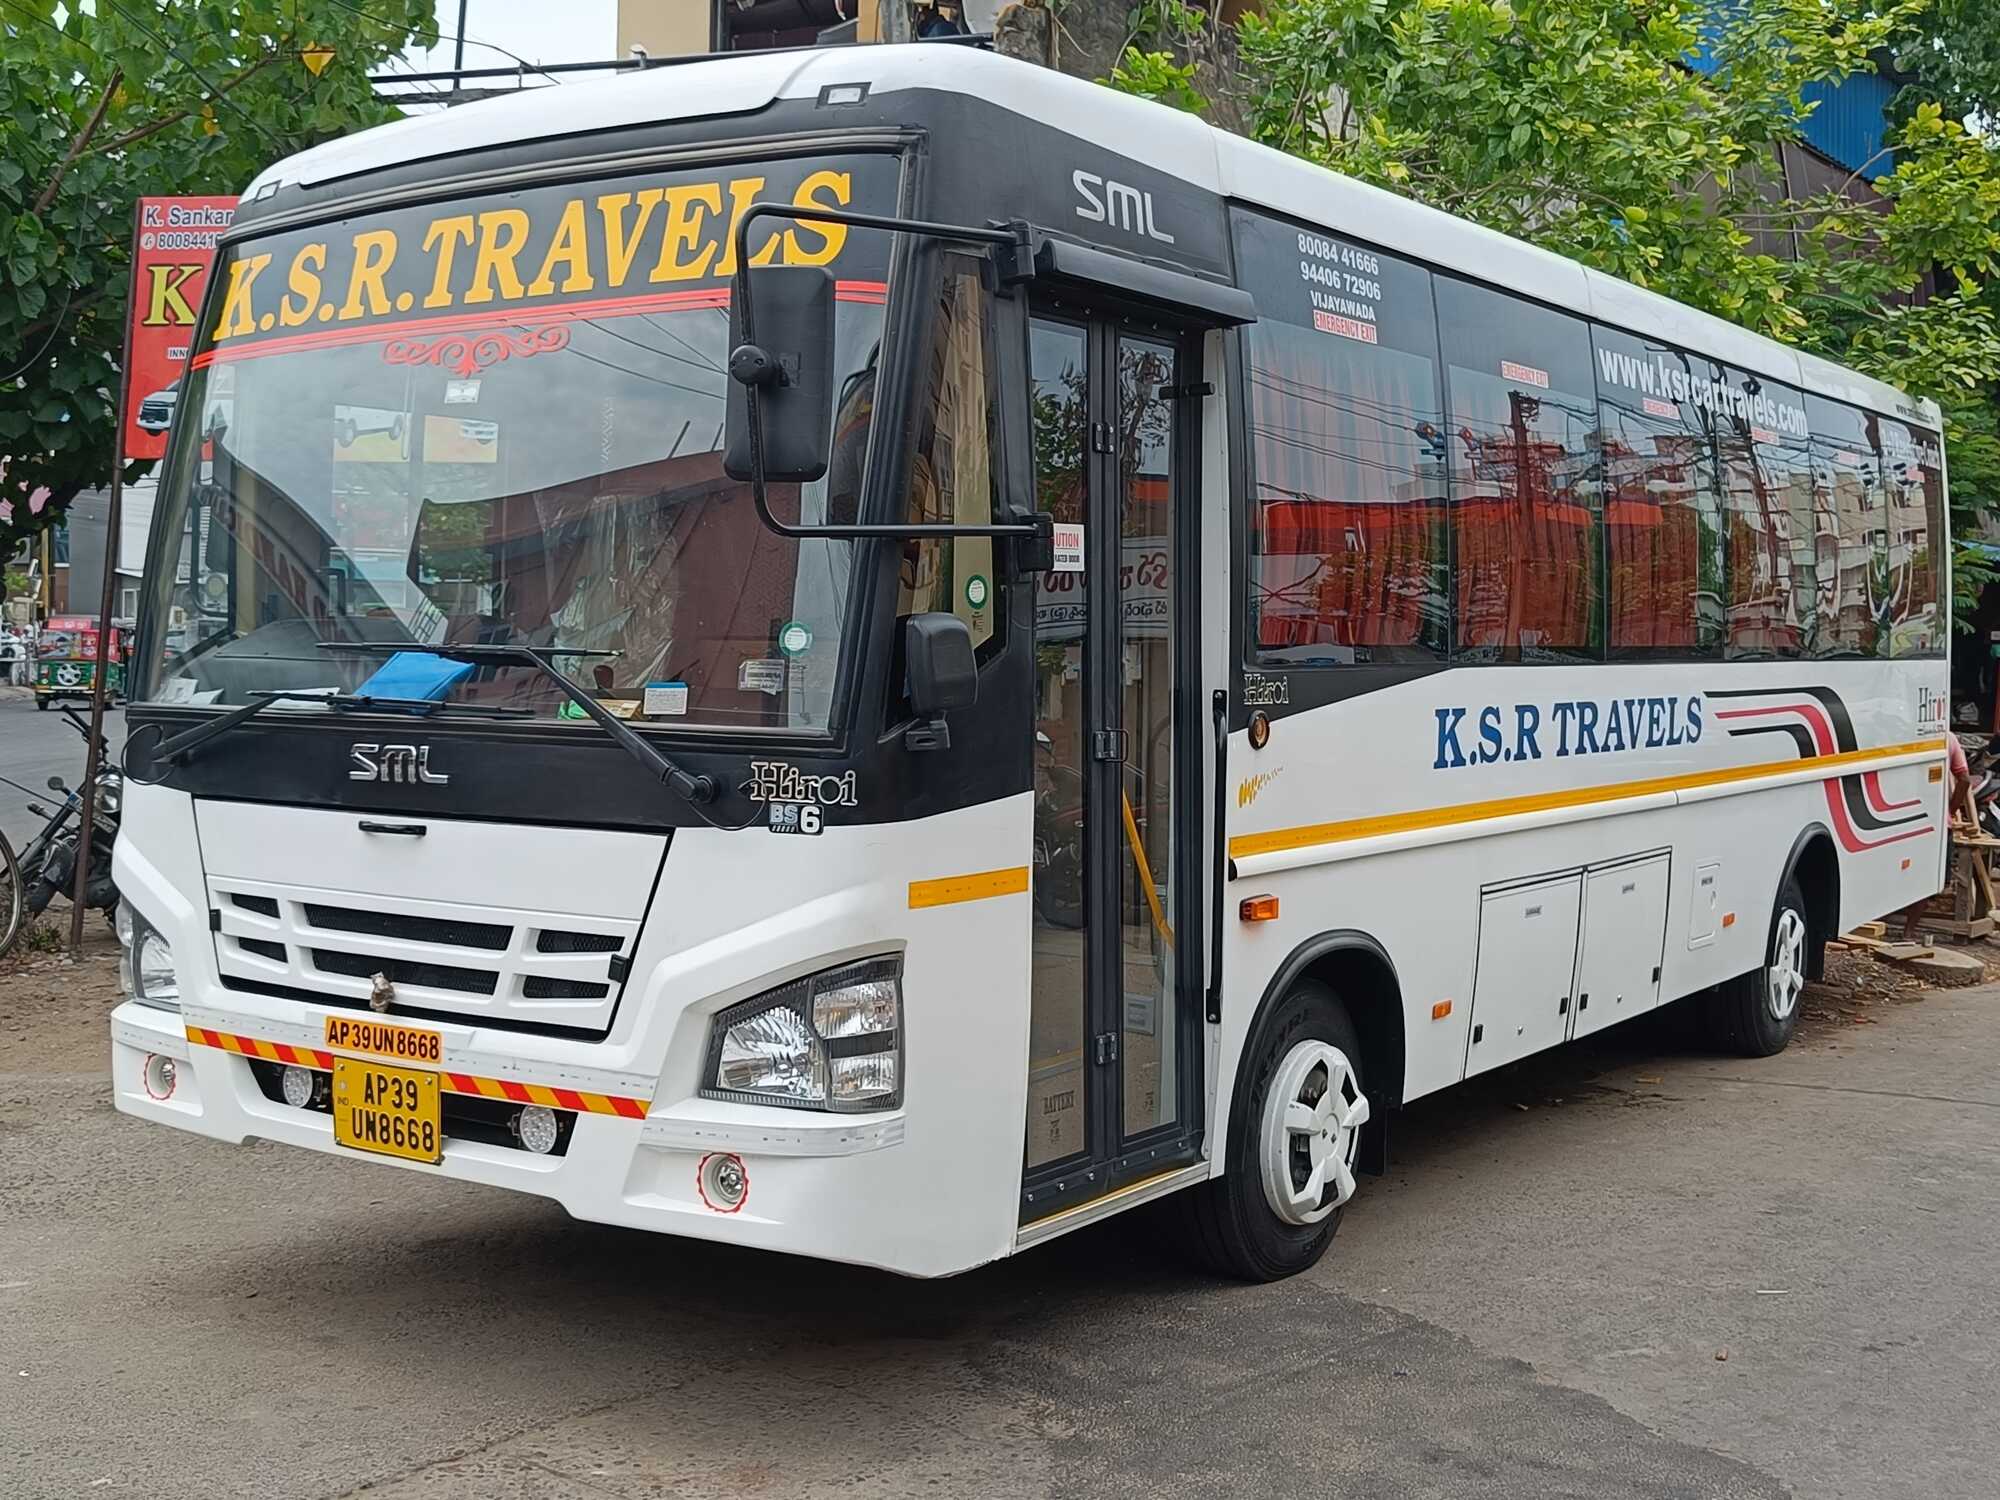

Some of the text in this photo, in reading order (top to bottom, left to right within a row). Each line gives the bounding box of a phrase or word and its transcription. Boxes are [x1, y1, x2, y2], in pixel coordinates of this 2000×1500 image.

[144, 206, 164, 226] K.
[1072, 169, 1174, 244] SML
[1298, 233, 1379, 275] 80084 41666
[1300, 261, 1381, 301] 94406 72906
[1310, 290, 1377, 322] VIJAYAWADA
[168, 349, 188, 360] INN
[1599, 348, 1809, 437] www.ksrcartravels.com
[1432, 696, 1702, 770] K.S.R TRAVELS
[348, 743, 450, 784] SML
[750, 761, 858, 807] Hiroi
[363, 1071, 419, 1113] AP39
[351, 1106, 434, 1153] UN8668
